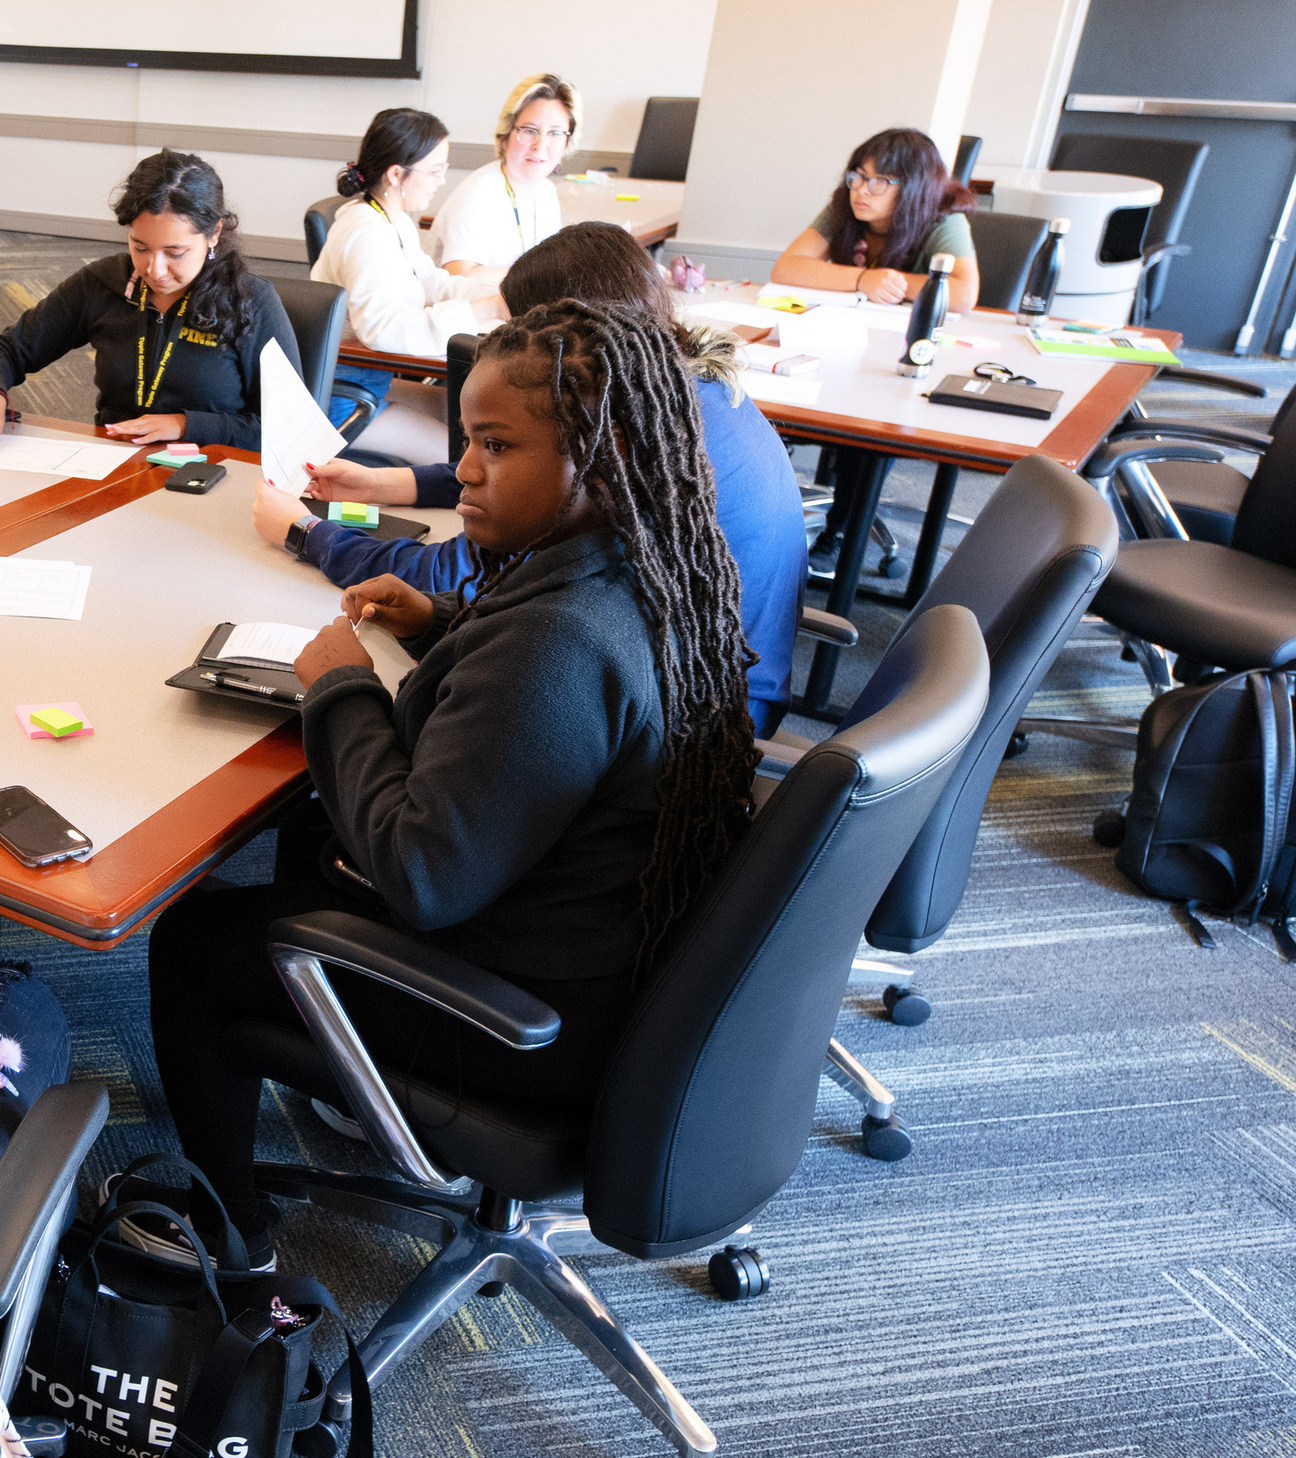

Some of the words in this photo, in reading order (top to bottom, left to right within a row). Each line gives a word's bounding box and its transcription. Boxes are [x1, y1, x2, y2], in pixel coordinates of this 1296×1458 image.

[160, 341, 174, 366] Program
[137, 380, 145, 406] Program
[25, 1364, 131, 1437] TOTE
[90, 1364, 179, 1413] THE
[63, 1418, 111, 1446] MARC
